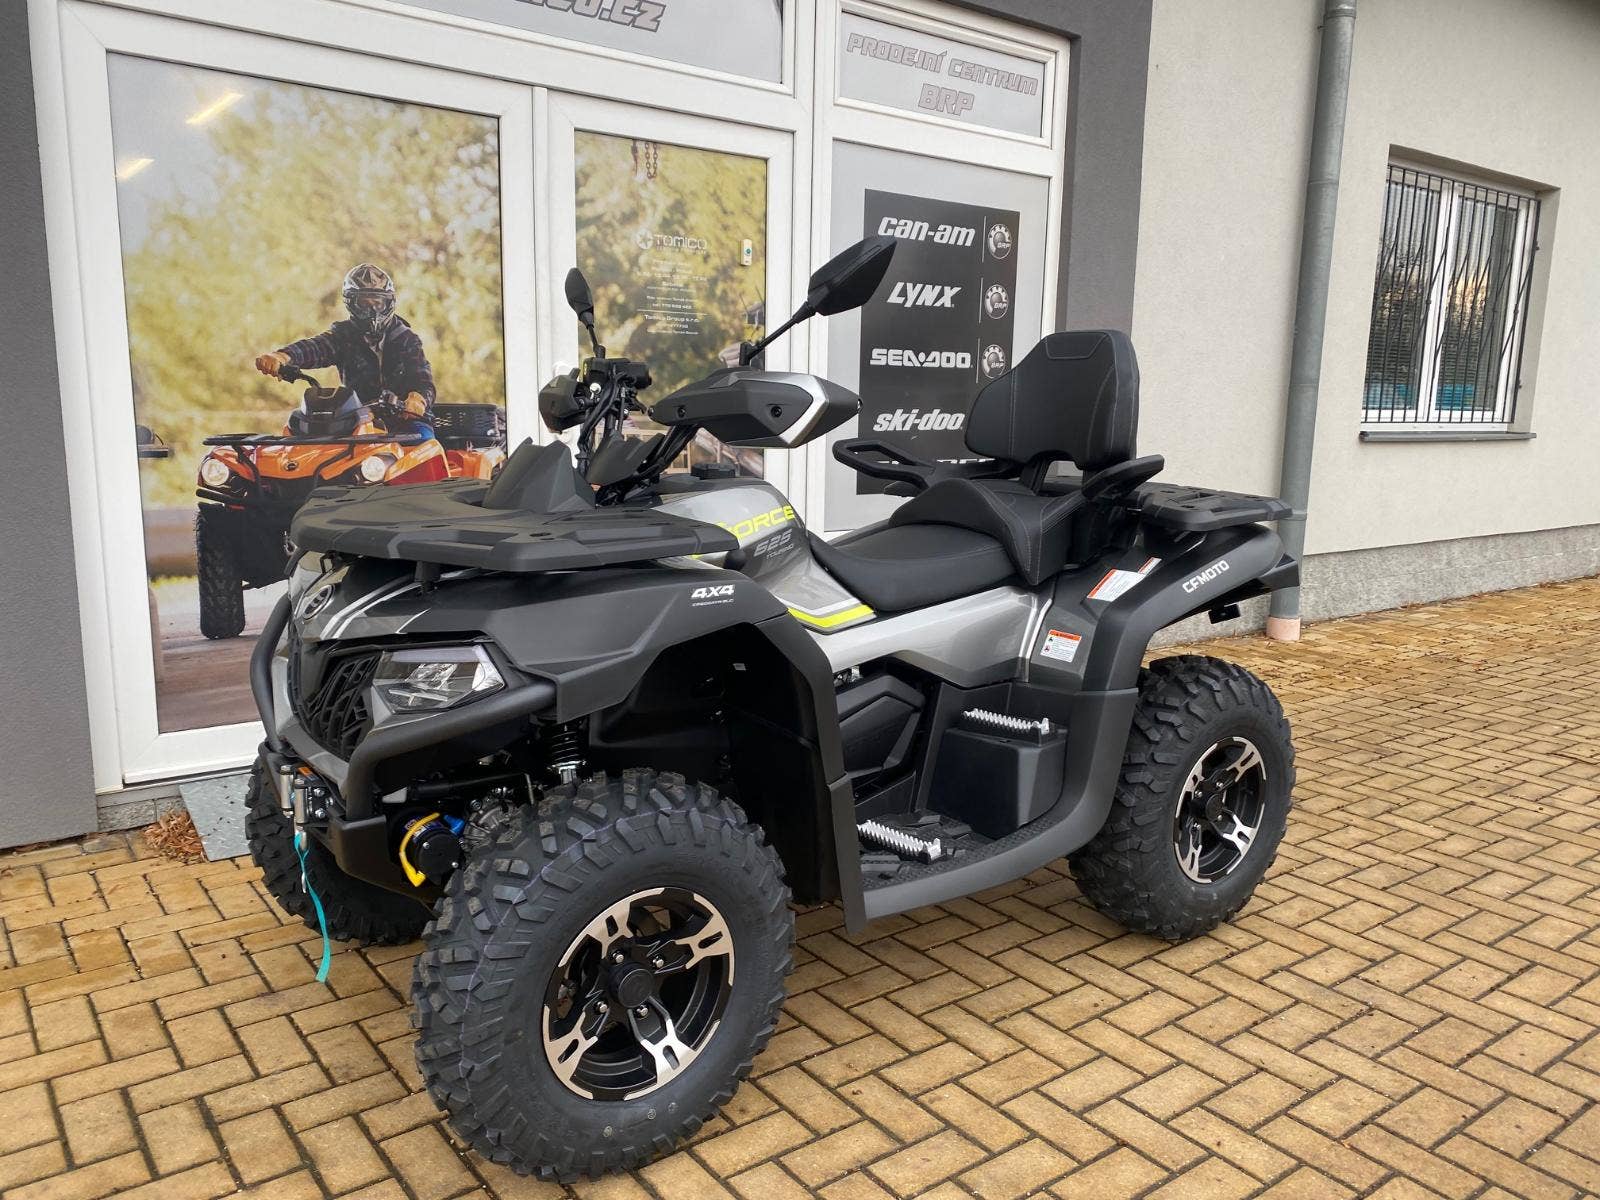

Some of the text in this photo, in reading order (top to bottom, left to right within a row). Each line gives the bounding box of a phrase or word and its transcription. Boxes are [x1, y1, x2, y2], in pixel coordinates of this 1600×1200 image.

[846, 32, 1039, 97] PRODEJNÍ CENTRUM
[917, 83, 975, 117] BRP
[878, 216, 976, 247] can-am
[887, 281, 962, 308] LYNX
[873, 408, 965, 432] ski-doo
[753, 528, 792, 557] 625
[1182, 560, 1230, 594] CFMOTO
